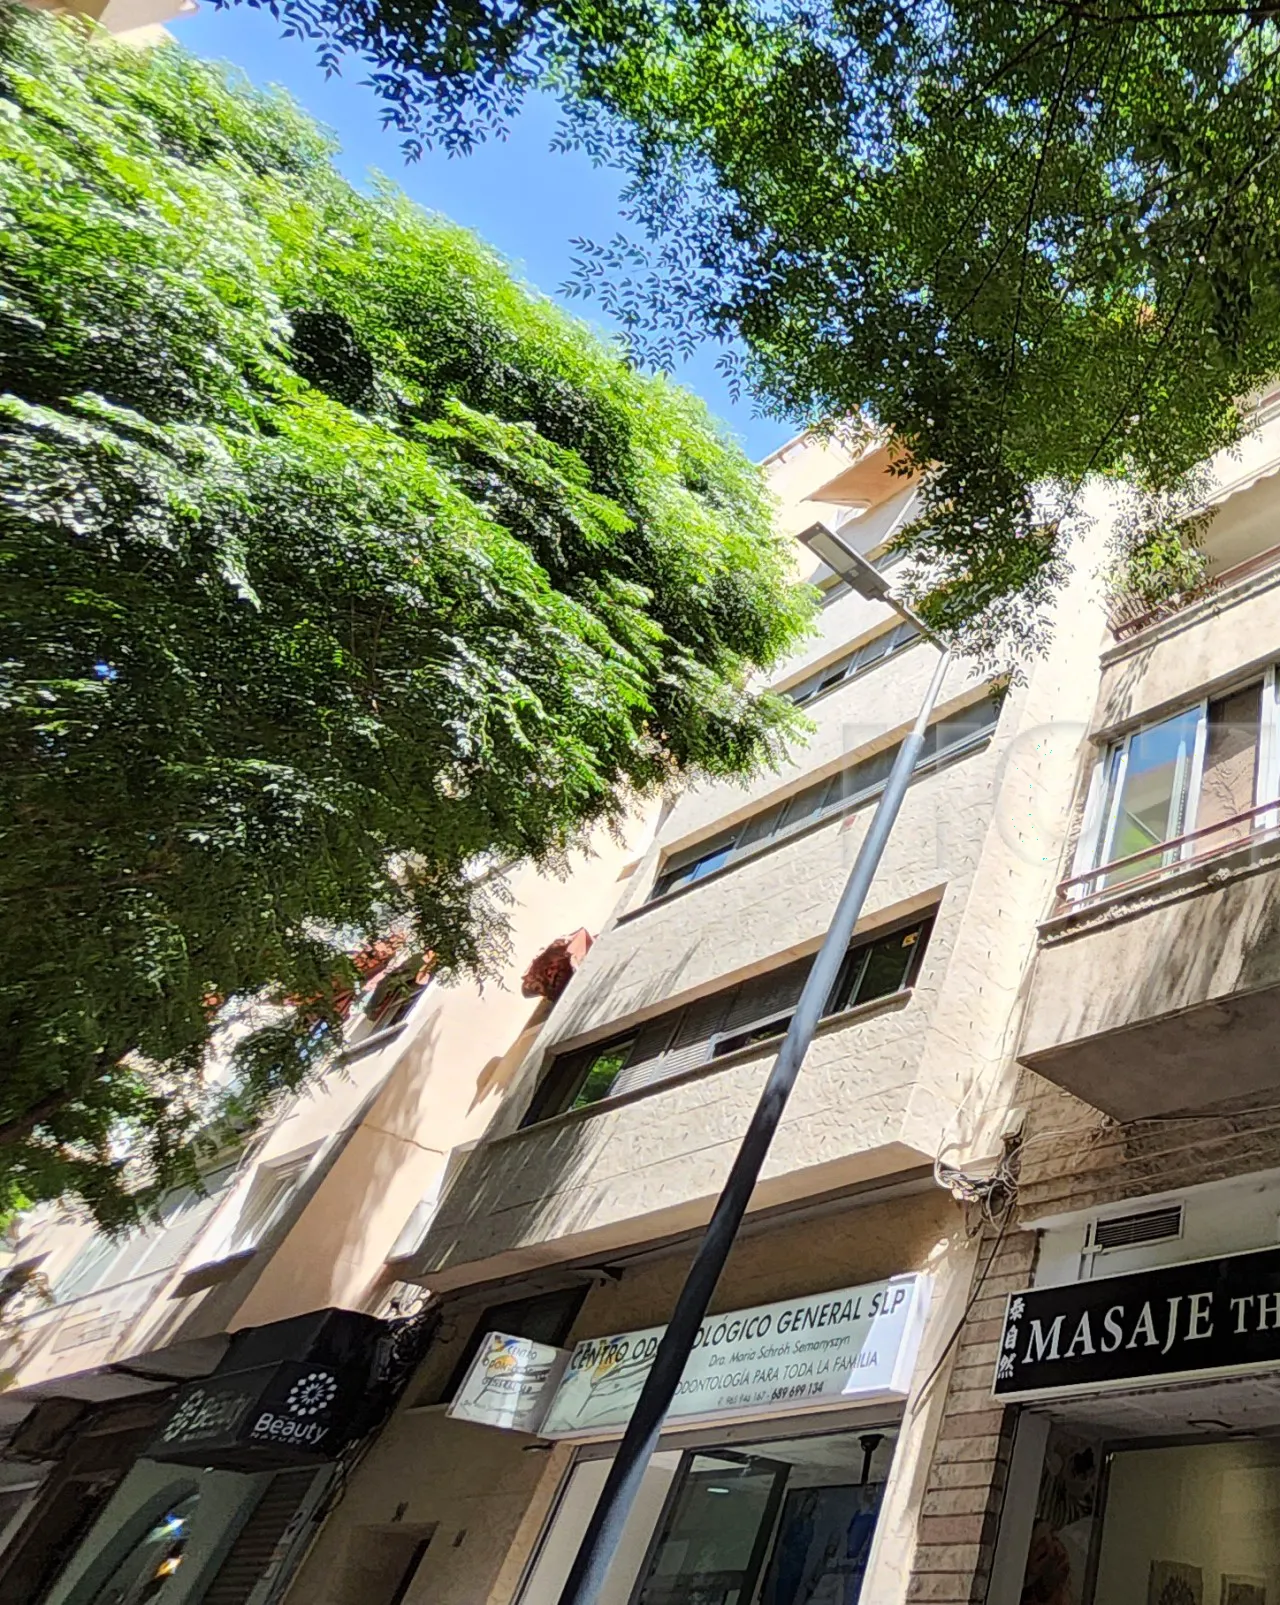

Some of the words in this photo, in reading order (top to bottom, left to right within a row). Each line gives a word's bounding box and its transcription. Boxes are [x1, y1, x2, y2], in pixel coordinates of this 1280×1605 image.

[571, 1342, 629, 1371] CENTRO
[776, 1295, 863, 1334] GENERAL
[867, 1288, 906, 1319] SLP
[1021, 1291, 1215, 1364] MASAJE
[752, 1367, 779, 1384] PARA
[783, 1362, 814, 1381] TODA
[817, 1359, 829, 1375] LA
[832, 1351, 878, 1371] FAMILIA
[254, 1413, 329, 1445] Beauty
